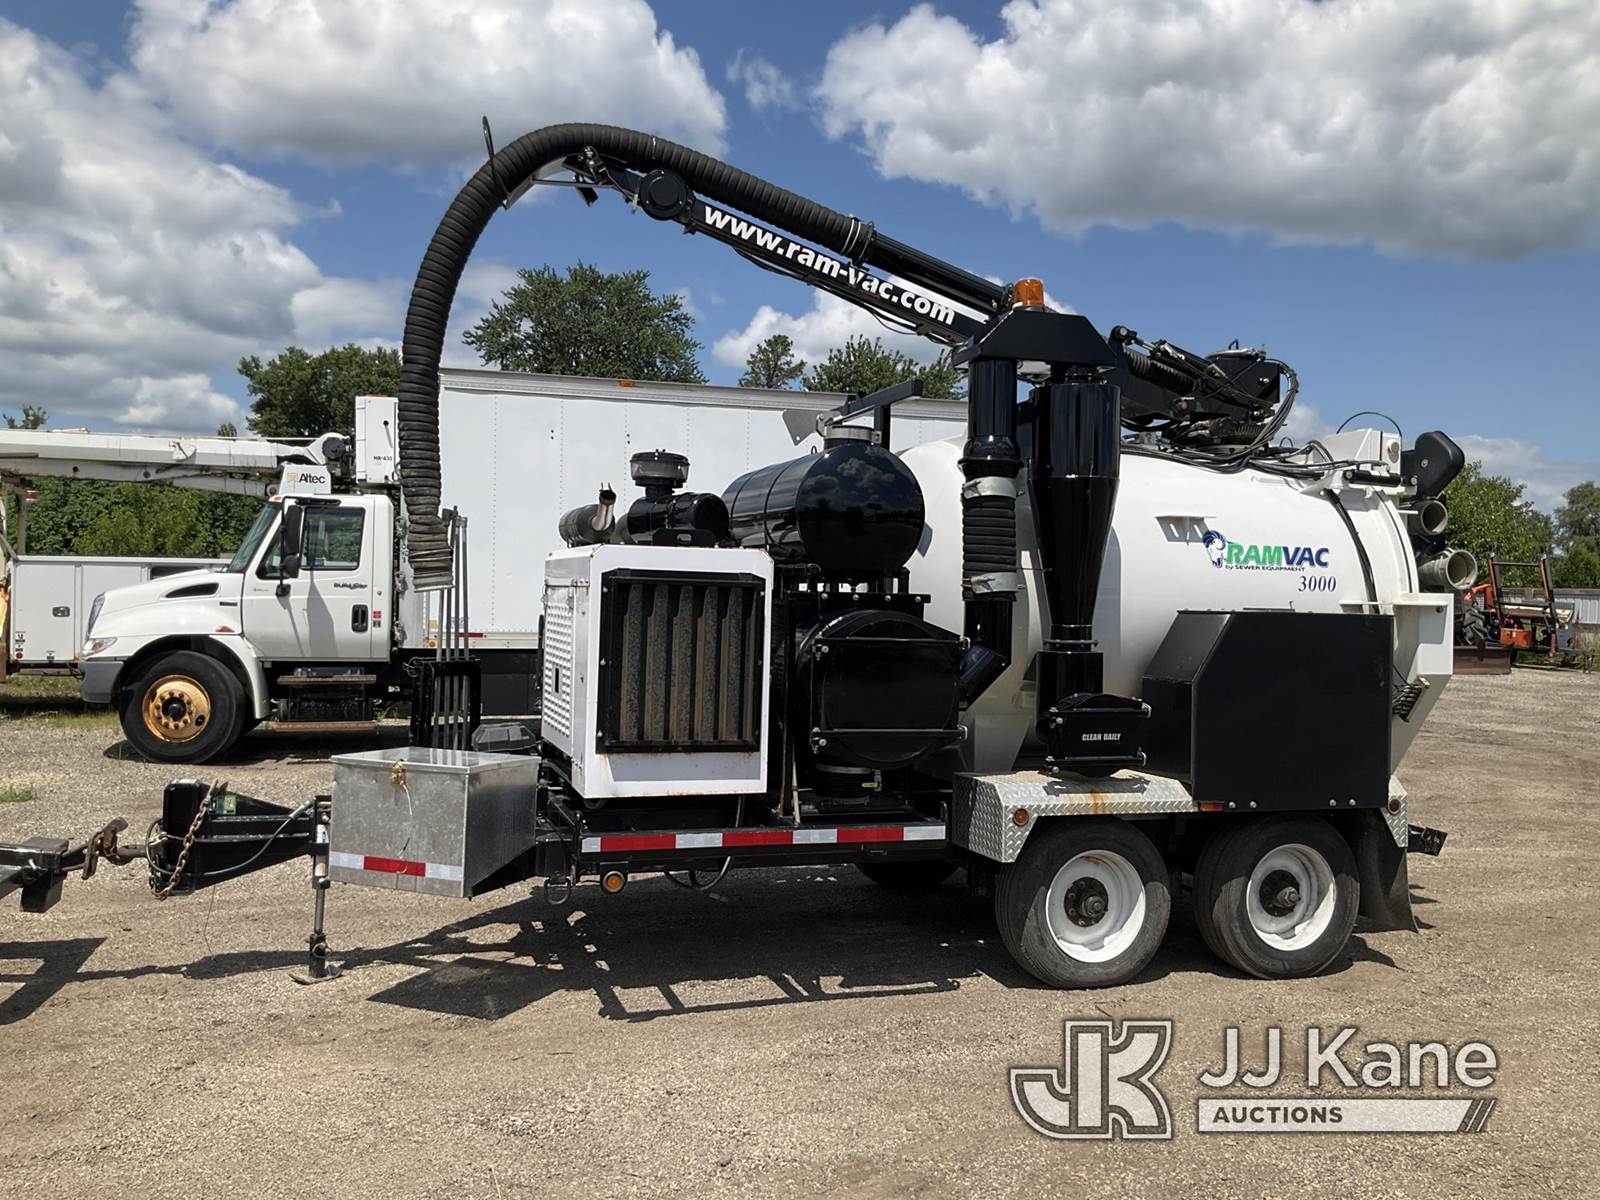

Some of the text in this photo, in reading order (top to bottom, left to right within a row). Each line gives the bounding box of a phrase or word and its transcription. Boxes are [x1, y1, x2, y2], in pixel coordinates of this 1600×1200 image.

[704, 205, 955, 325] www.ram-vac.com
[299, 473, 326, 484] Altec
[1225, 544, 1329, 567] RAMVAC
[1298, 576, 1337, 592] 3000
[1082, 733, 1121, 741] CLEAN DAILY
